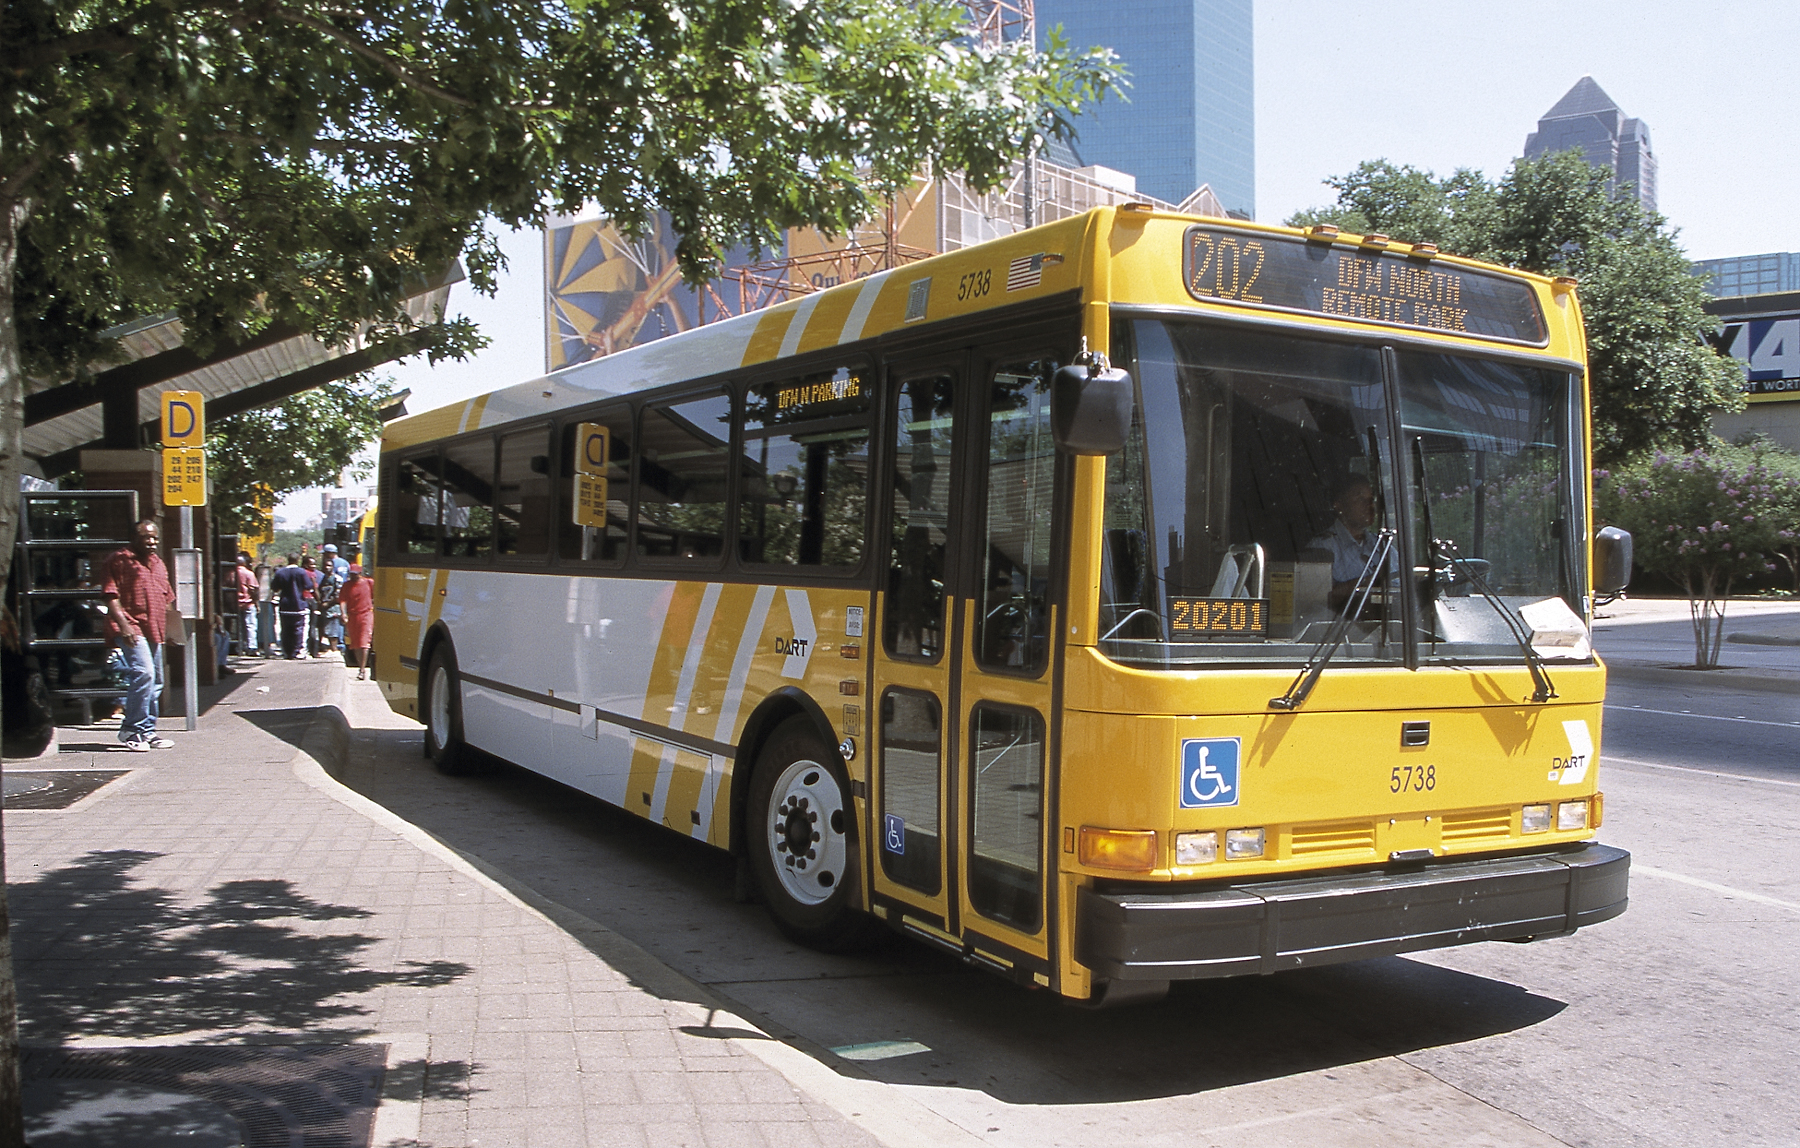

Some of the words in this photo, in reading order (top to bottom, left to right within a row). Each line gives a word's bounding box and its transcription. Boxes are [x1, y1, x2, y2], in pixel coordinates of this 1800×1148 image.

[1190, 232, 1265, 303] 202
[1338, 256, 1382, 292] DFW
[1389, 264, 1461, 305] NORTH
[957, 268, 992, 302] 5738
[1322, 286, 1407, 324] REMOTE
[1413, 301, 1469, 332] PARK
[778, 388, 799, 409] DFW
[801, 386, 810, 404] N
[811, 377, 860, 403] PARKING
[168, 401, 196, 438] D
[1173, 601, 1262, 630] 20201
[775, 637, 808, 657] DART
[1552, 755, 1585, 769] DART
[1390, 765, 1436, 793] 5738
